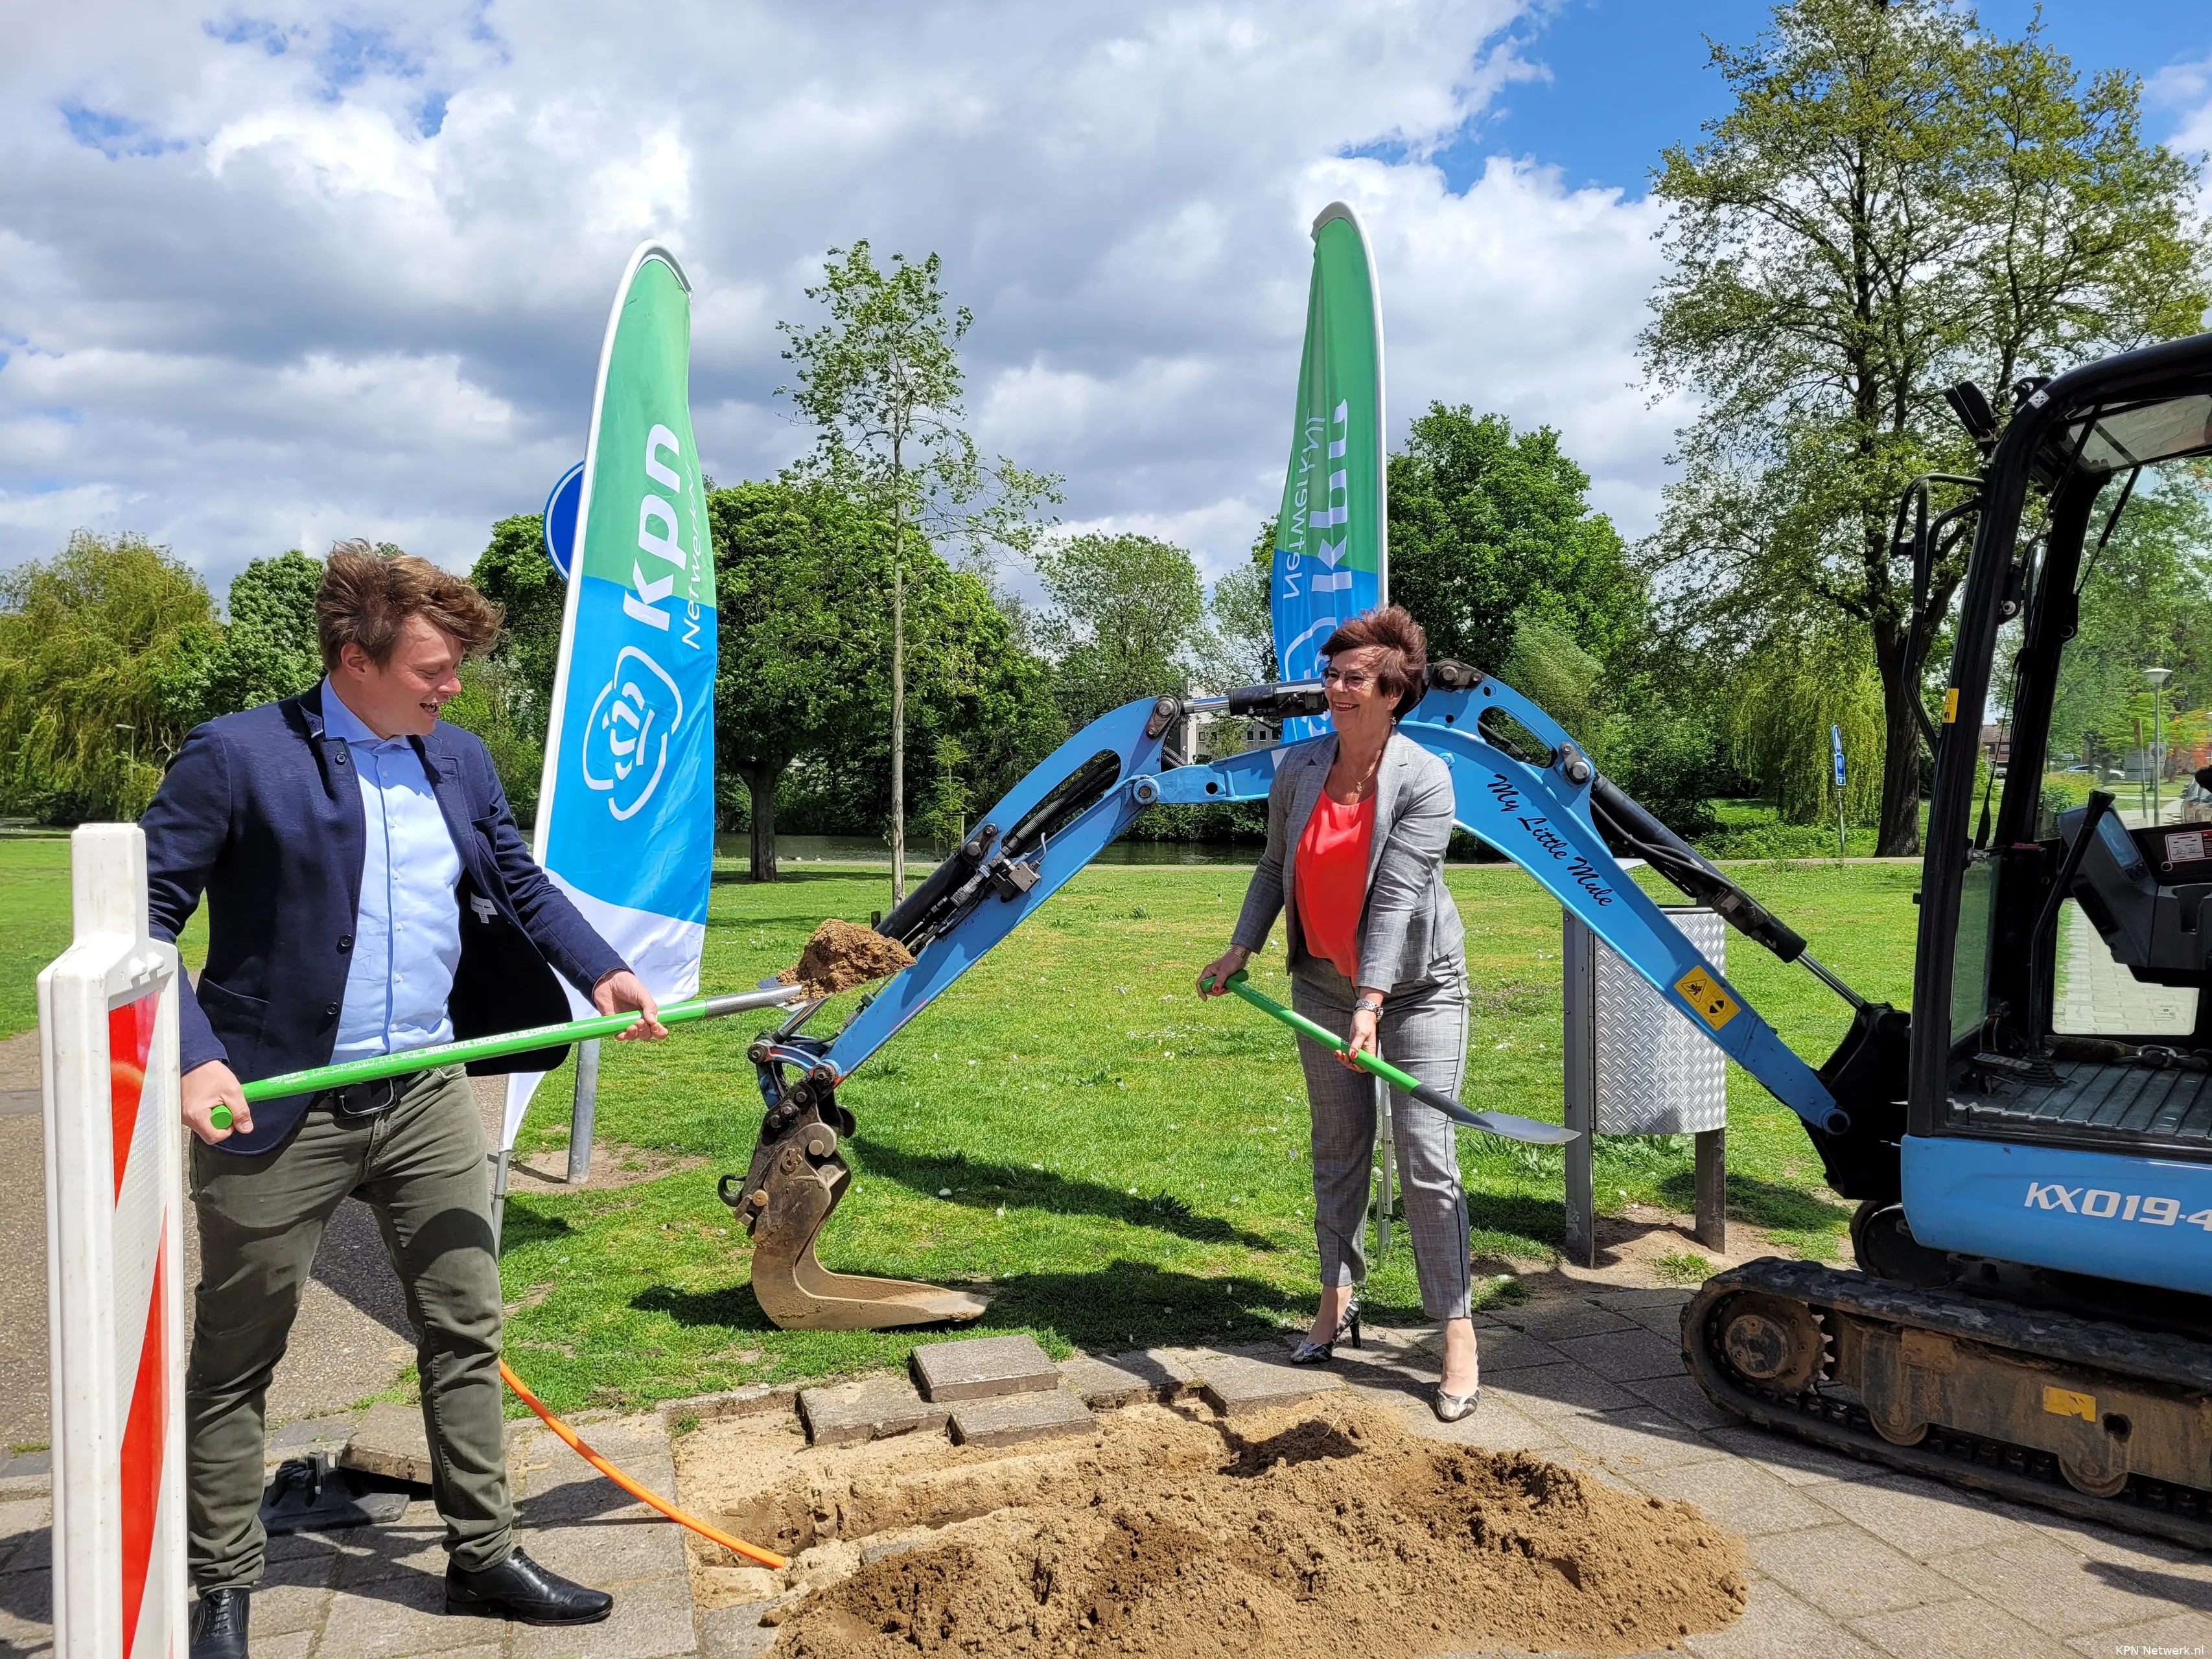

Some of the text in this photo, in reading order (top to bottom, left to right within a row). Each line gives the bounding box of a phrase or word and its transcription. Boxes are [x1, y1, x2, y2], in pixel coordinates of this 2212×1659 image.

[623, 423, 687, 631] kpn
[1487, 773, 1613, 907] My Little Mule
[426, 1041, 471, 1054] NIEUWE
[2024, 1182, 2212, 1231] KX019-4
